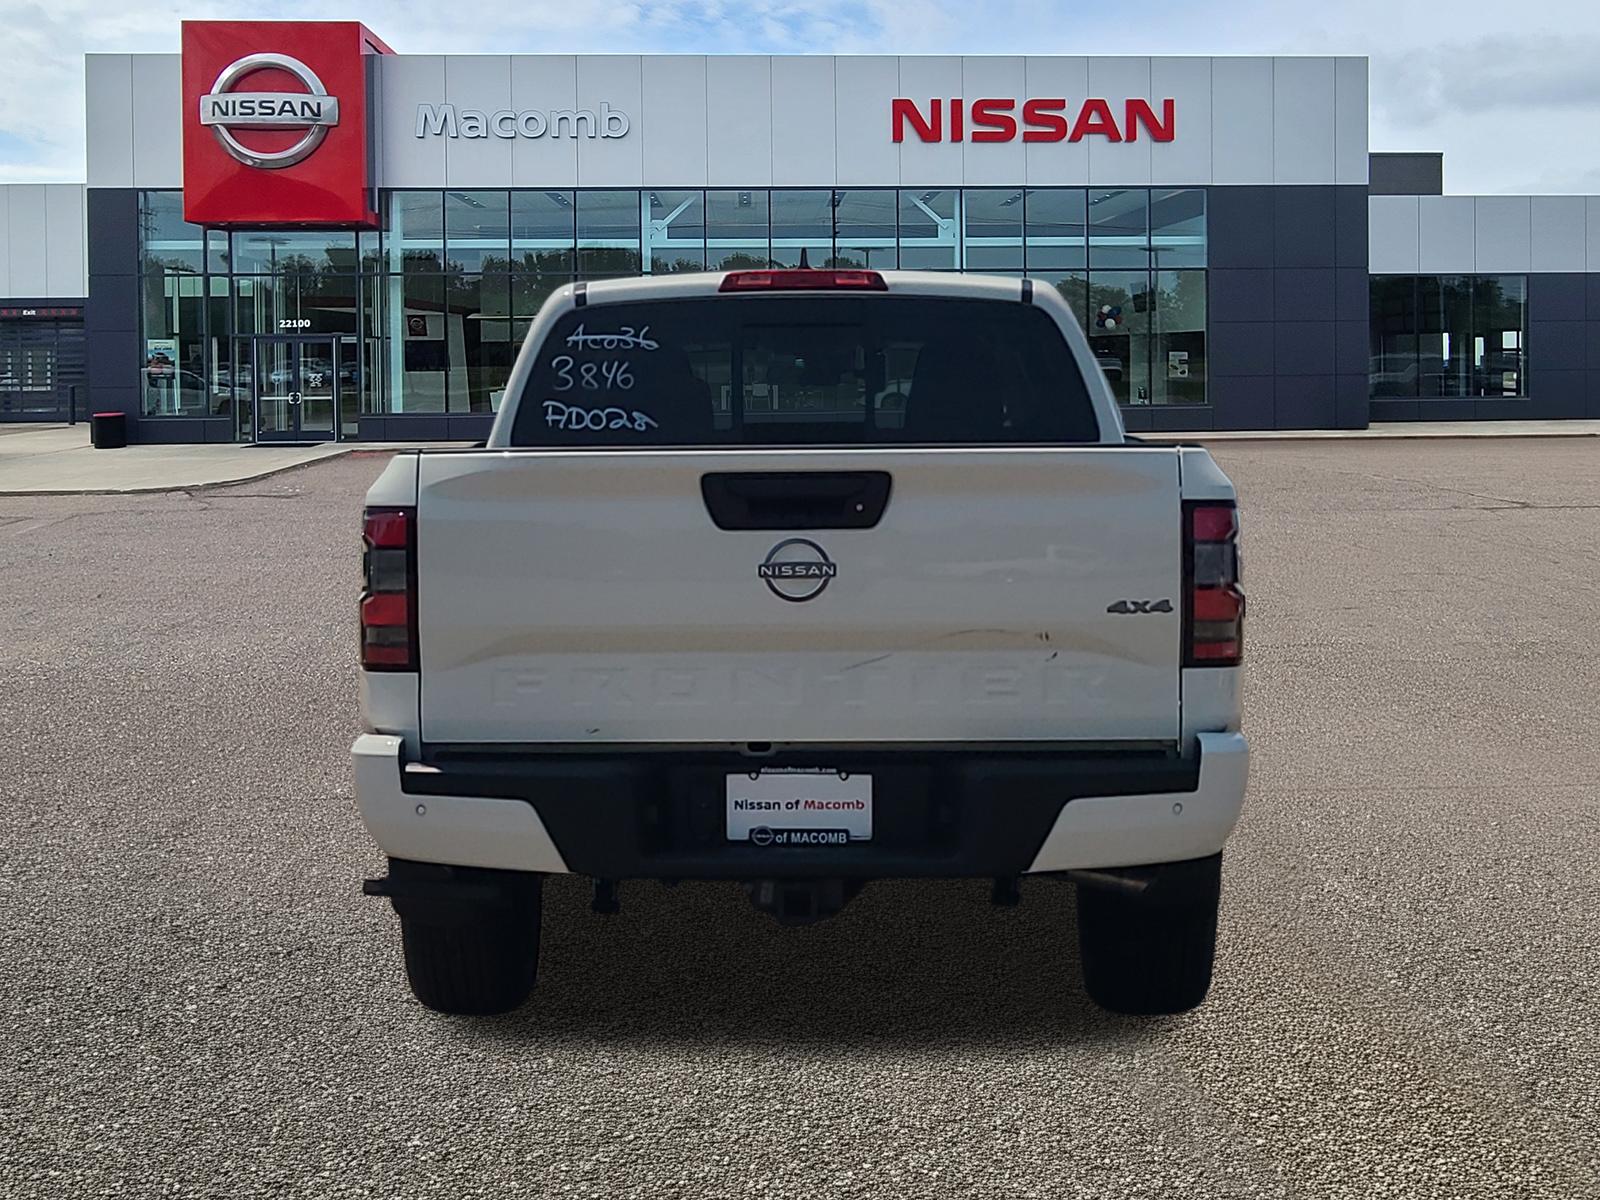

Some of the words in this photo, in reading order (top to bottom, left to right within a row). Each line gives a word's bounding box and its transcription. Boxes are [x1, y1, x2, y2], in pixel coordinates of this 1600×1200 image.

[211, 98, 322, 119] NISSAN
[415, 102, 630, 139] Macomb
[892, 98, 1176, 143] NISSAN
[279, 319, 311, 328] 22100
[551, 356, 634, 391] 3846
[760, 566, 835, 577] NISSAN
[493, 667, 1111, 707] FRONTIER
[734, 800, 781, 810] Nissan
[785, 800, 800, 810] of
[803, 800, 865, 810] Macomb
[776, 832, 787, 843] of
[791, 832, 847, 843] MACOMB
